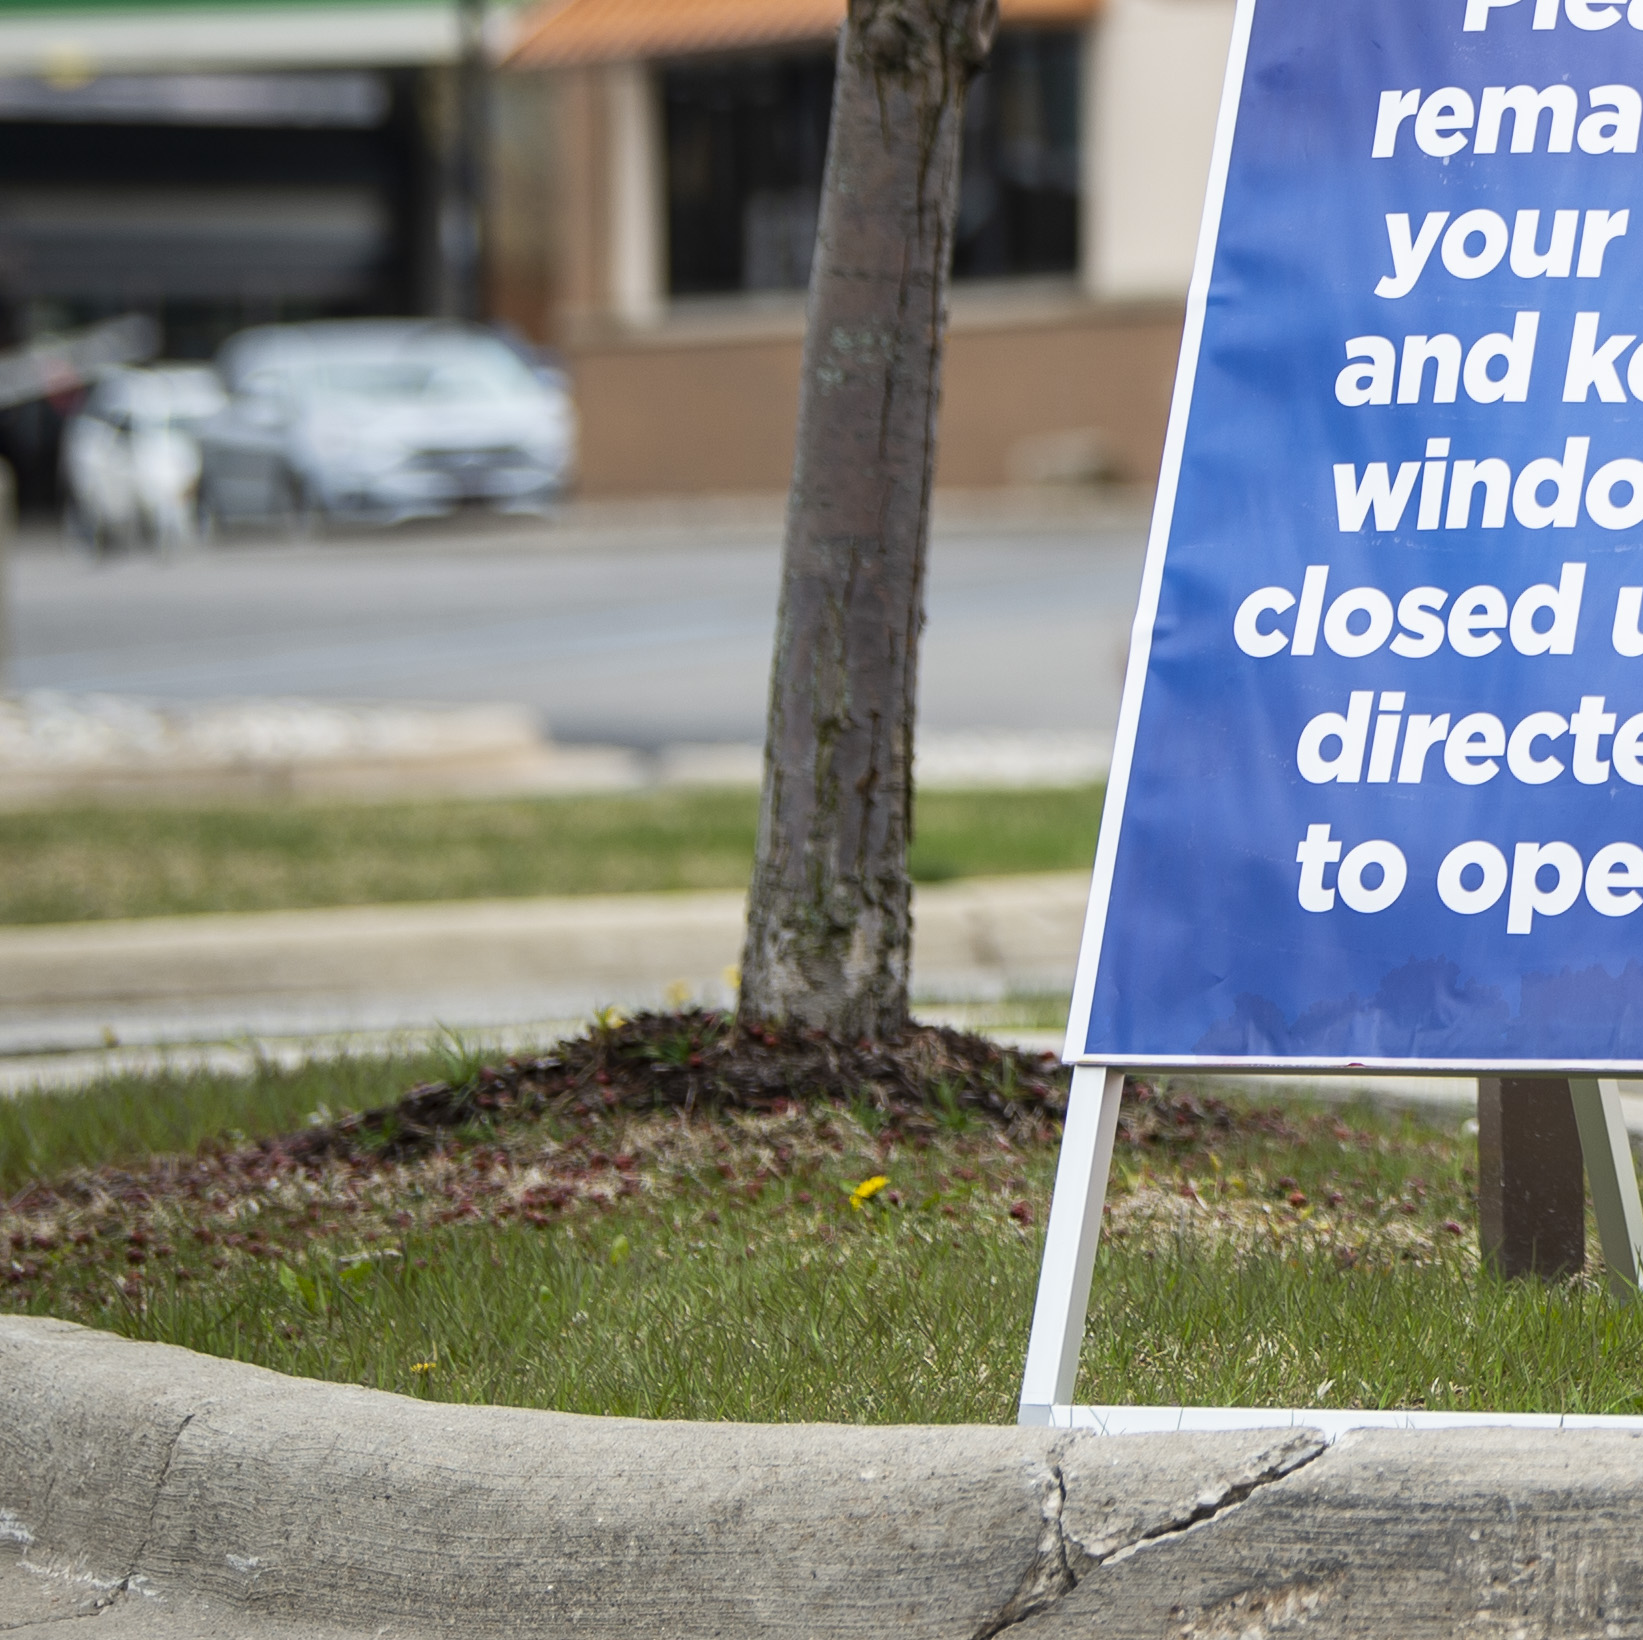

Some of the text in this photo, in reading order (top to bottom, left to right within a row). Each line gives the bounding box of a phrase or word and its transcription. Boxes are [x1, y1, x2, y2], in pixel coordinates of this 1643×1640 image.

[1374, 209, 1629, 298] your
[1335, 312, 1539, 406] and
[1234, 563, 1587, 658] closed
[1296, 824, 1407, 913] to
